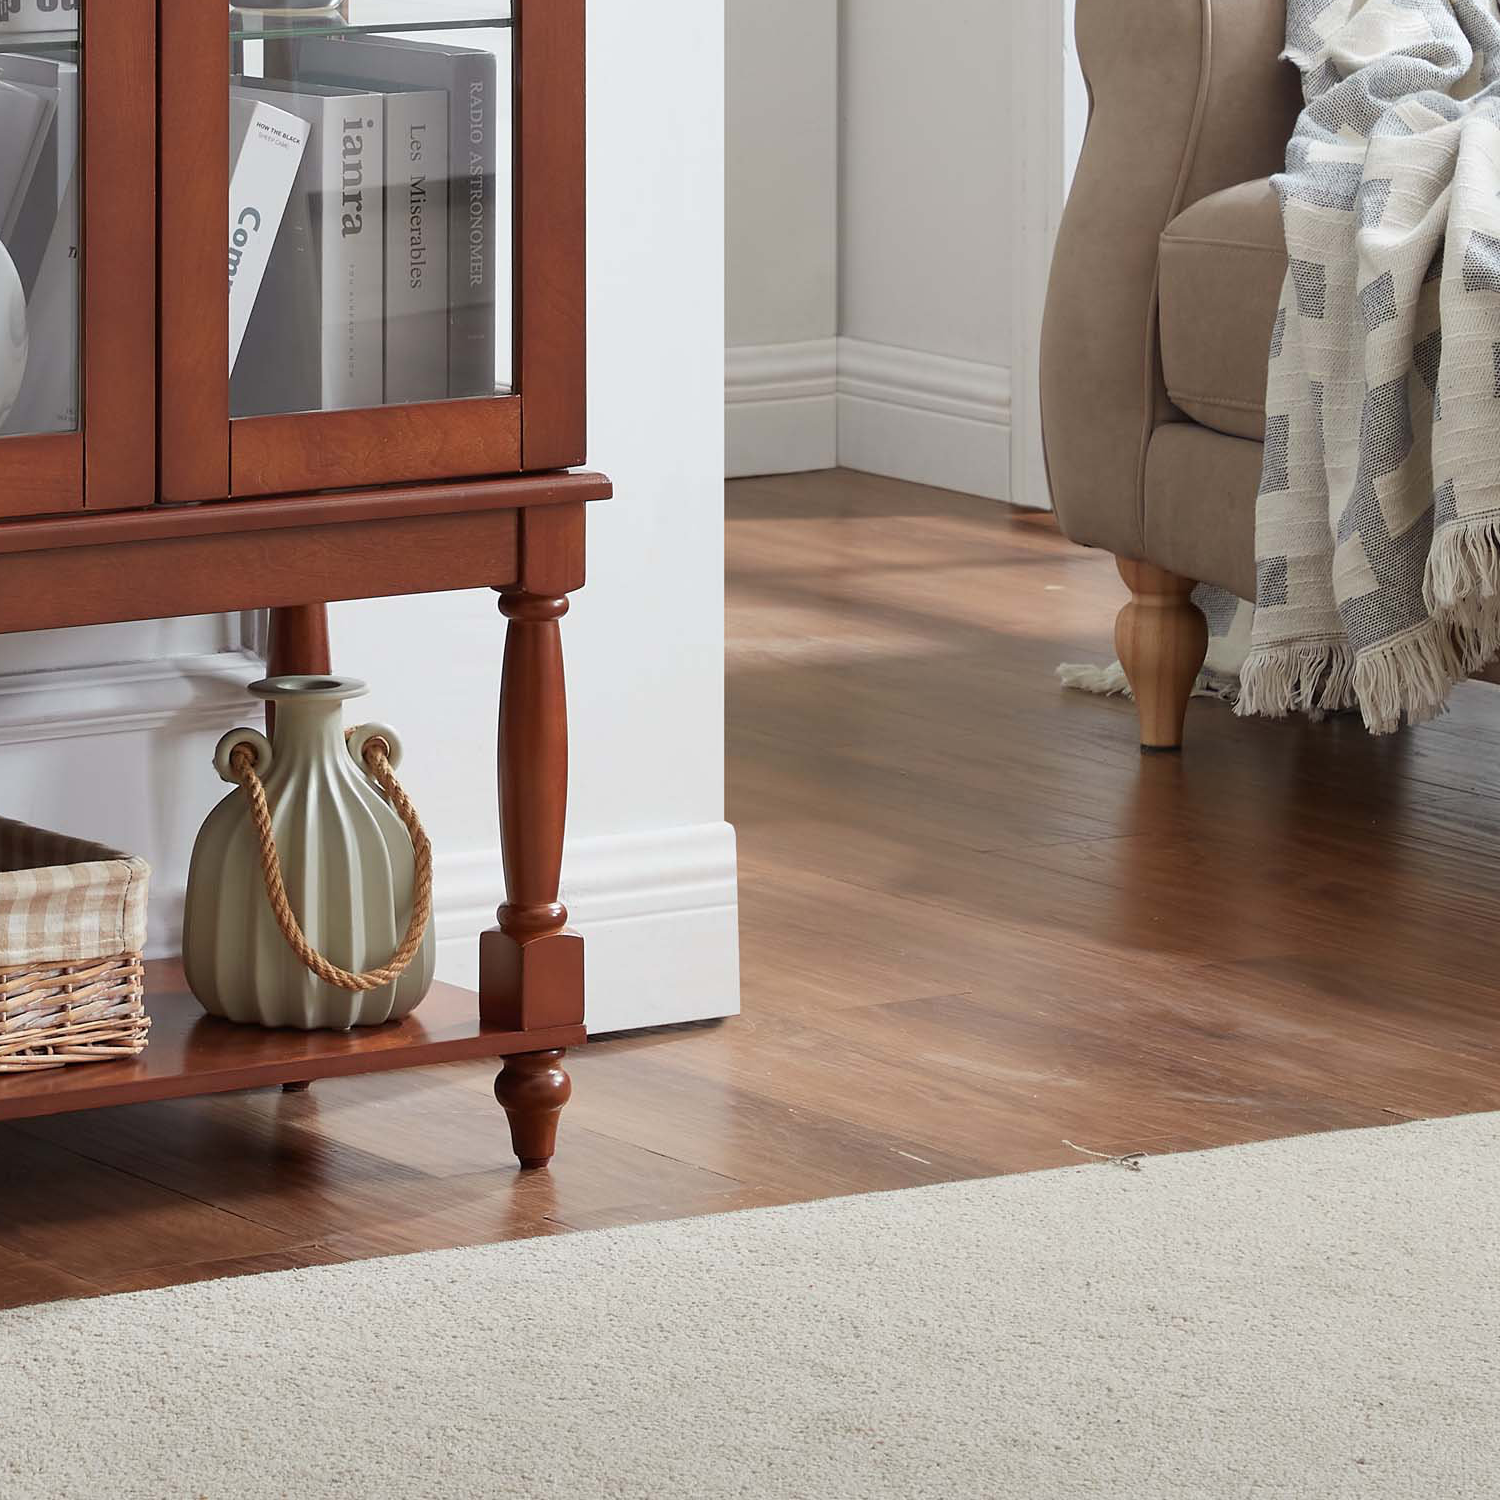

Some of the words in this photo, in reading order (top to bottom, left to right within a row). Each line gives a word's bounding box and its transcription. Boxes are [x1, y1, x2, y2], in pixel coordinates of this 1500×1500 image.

[256, 121, 270, 132] HOW
[270, 127, 282, 137] THE
[282, 132, 301, 145] BLACK
[409, 123, 426, 162] Les
[468, 80, 485, 143] RADIO
[341, 116, 375, 239] ianra
[467, 152, 485, 288] ASTRONOMER
[409, 175, 427, 290] Miserables
